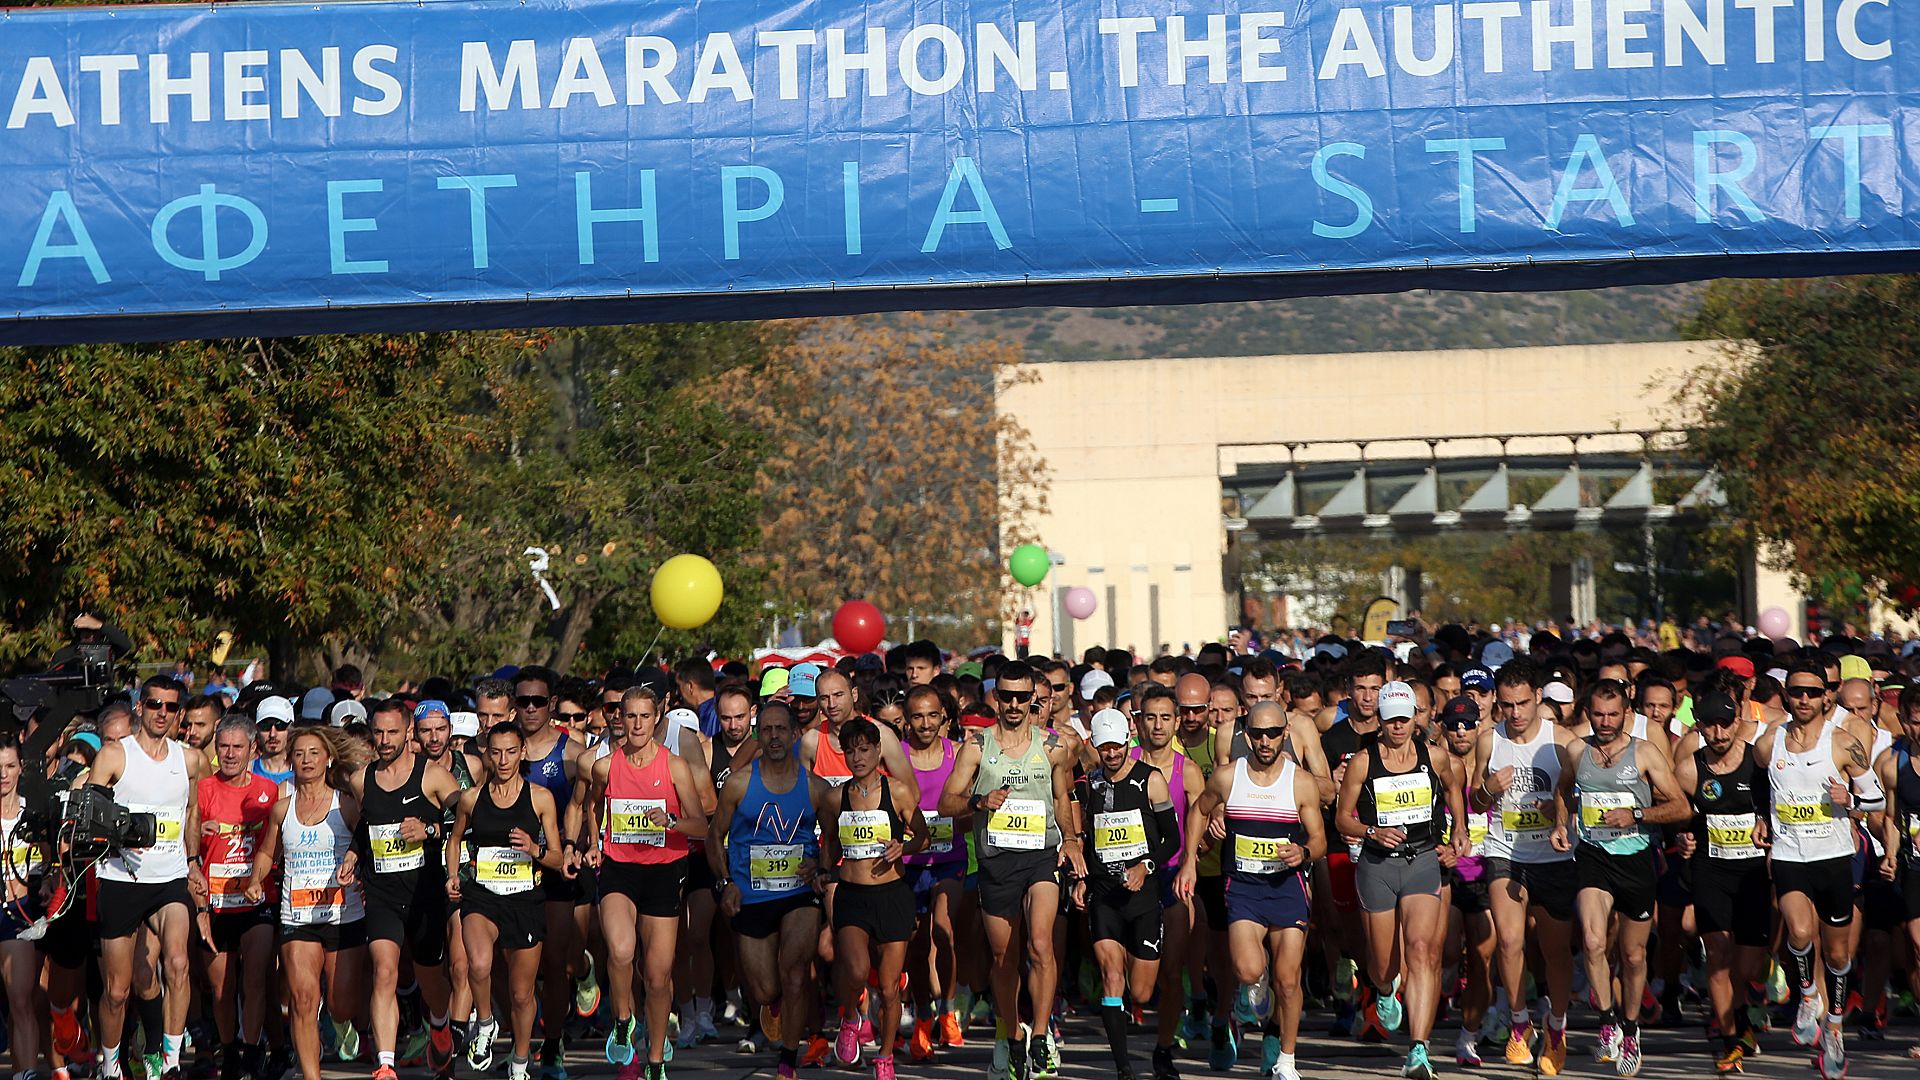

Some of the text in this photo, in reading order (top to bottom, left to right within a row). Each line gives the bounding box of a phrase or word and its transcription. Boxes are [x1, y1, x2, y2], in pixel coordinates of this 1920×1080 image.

[7, 0, 1892, 129] ATHENS MARATHON. THE AUTHENTIC
[18, 157, 1013, 287] ΑΦΕΤΗΡΙΑ
[1311, 124, 1892, 239] START
[1515, 767, 1533, 775] THE
[1002, 775, 1028, 784] PROTEIN
[1511, 784, 1535, 793] FACE
[1395, 790, 1415, 804] 401
[1518, 812, 1540, 825] 232
[1792, 806, 1814, 818] 209
[628, 815, 649, 828] 410
[1007, 815, 1028, 828] 201
[853, 826, 874, 839] 405
[1108, 828, 1129, 841] 202
[1725, 830, 1746, 841] 227
[226, 836, 256, 859] 25
[385, 840, 406, 852] 249
[1252, 842, 1274, 855] 215
[291, 850, 337, 859] MARATHON
[290, 861, 307, 869] TEAM
[495, 863, 516, 875] 406
[768, 860, 789, 872] 319
[309, 889, 329, 902] 101
